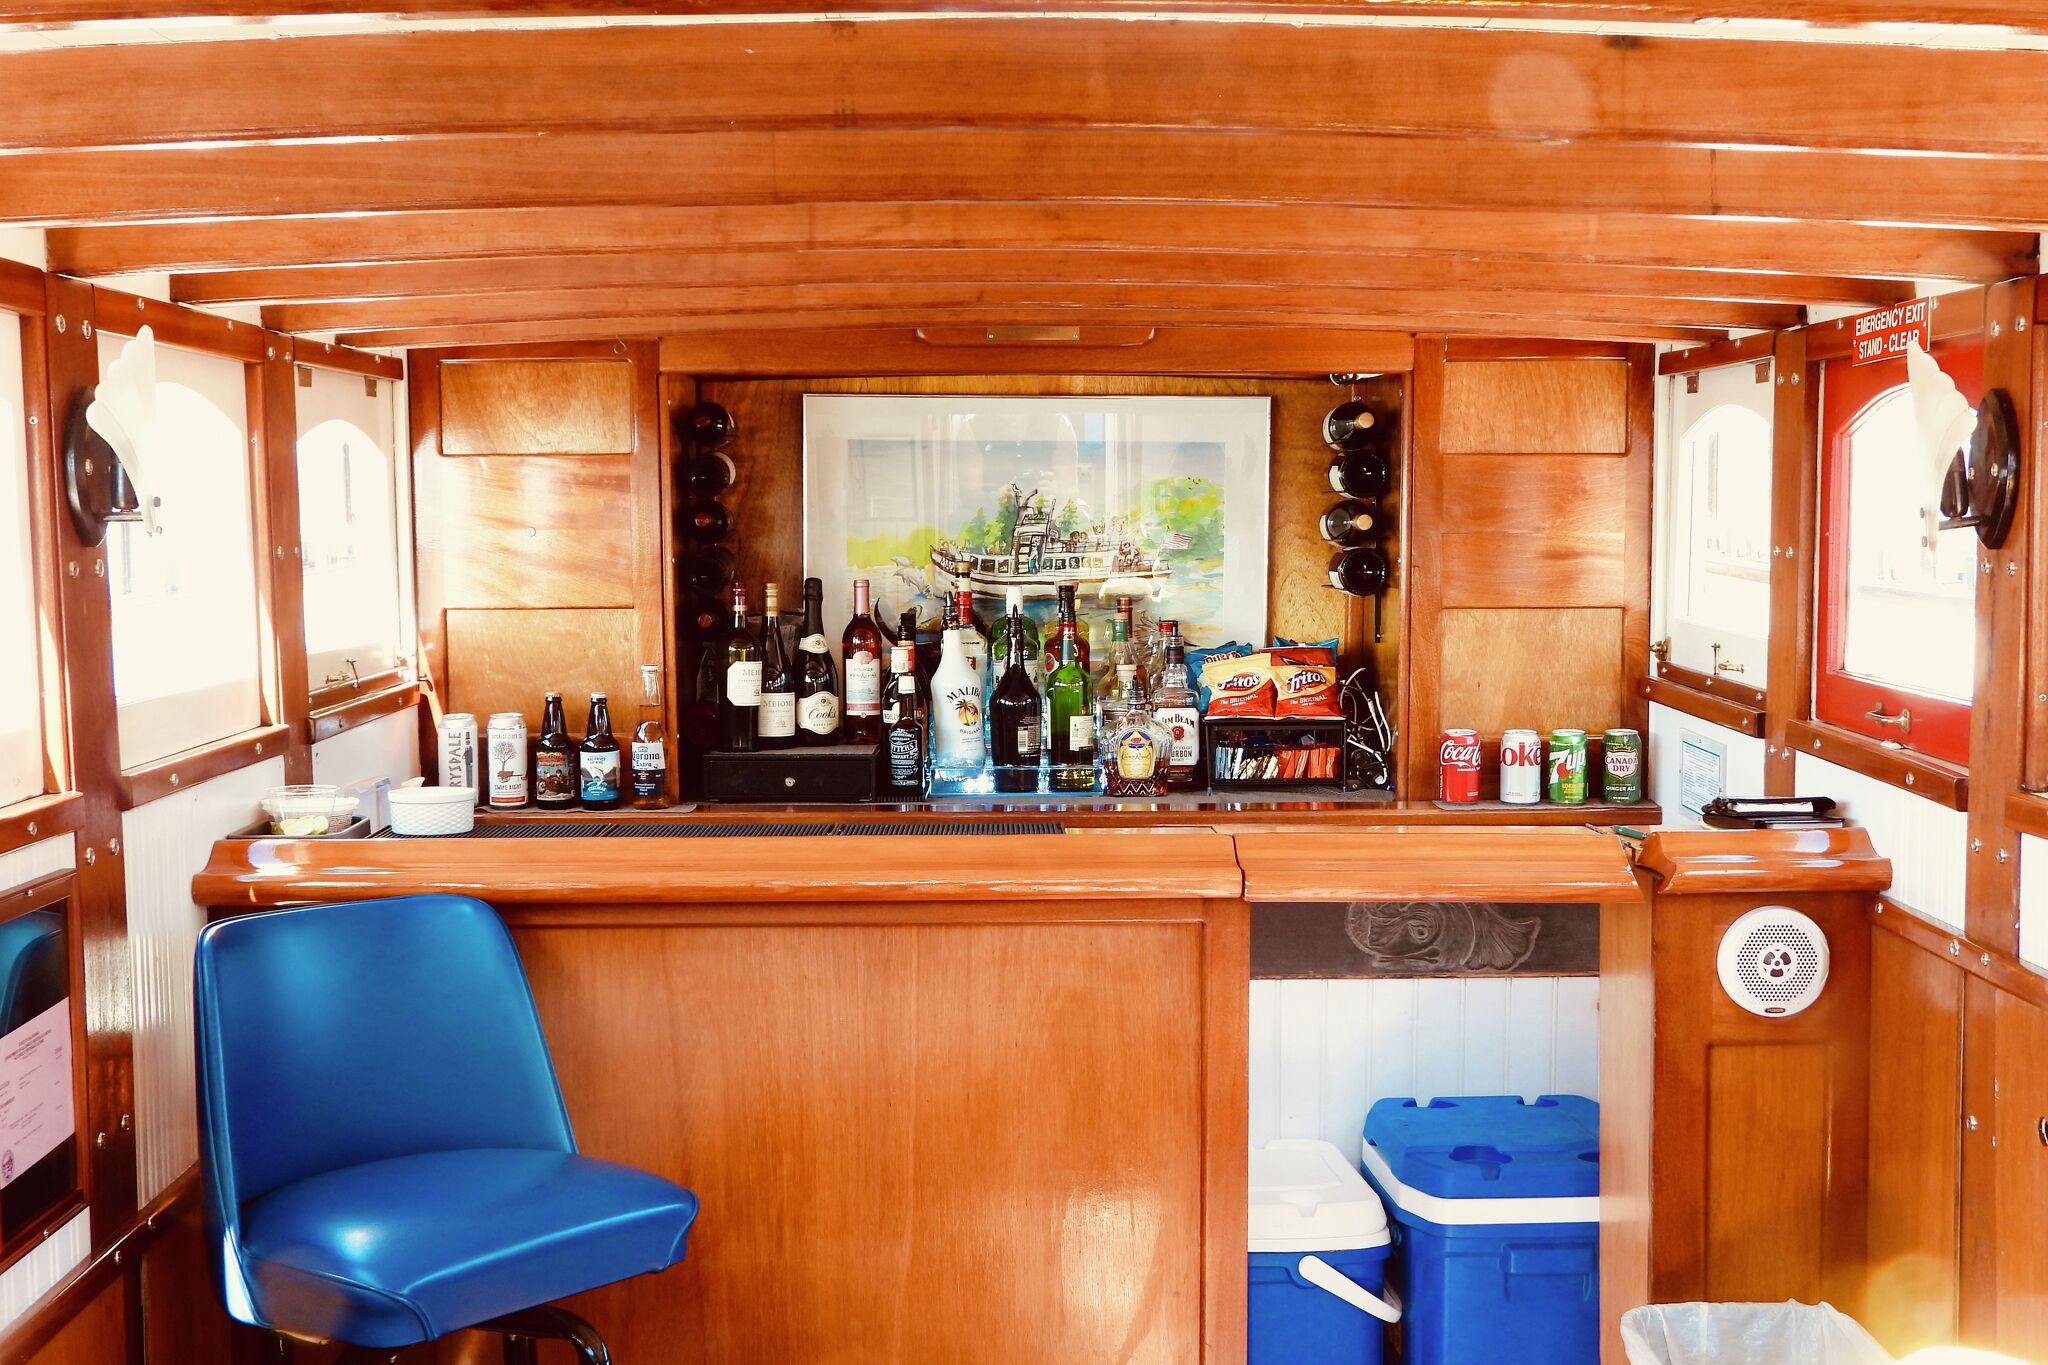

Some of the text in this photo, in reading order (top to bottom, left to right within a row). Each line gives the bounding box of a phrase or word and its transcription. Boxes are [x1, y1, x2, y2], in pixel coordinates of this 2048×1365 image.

[1855, 302, 1926, 337] EMERGENCY EXIT
[1859, 336, 1883, 360] STAND
[1229, 694, 1259, 704] ORIGINAL
[808, 705, 837, 721] Cook's
[1174, 713, 1195, 729] BEAM
[632, 750, 660, 761] Corona
[1171, 749, 1193, 758] URBON
[1500, 742, 1541, 767] oke
[1604, 756, 1639, 765] CANADA
[1613, 764, 1631, 772] DRY
